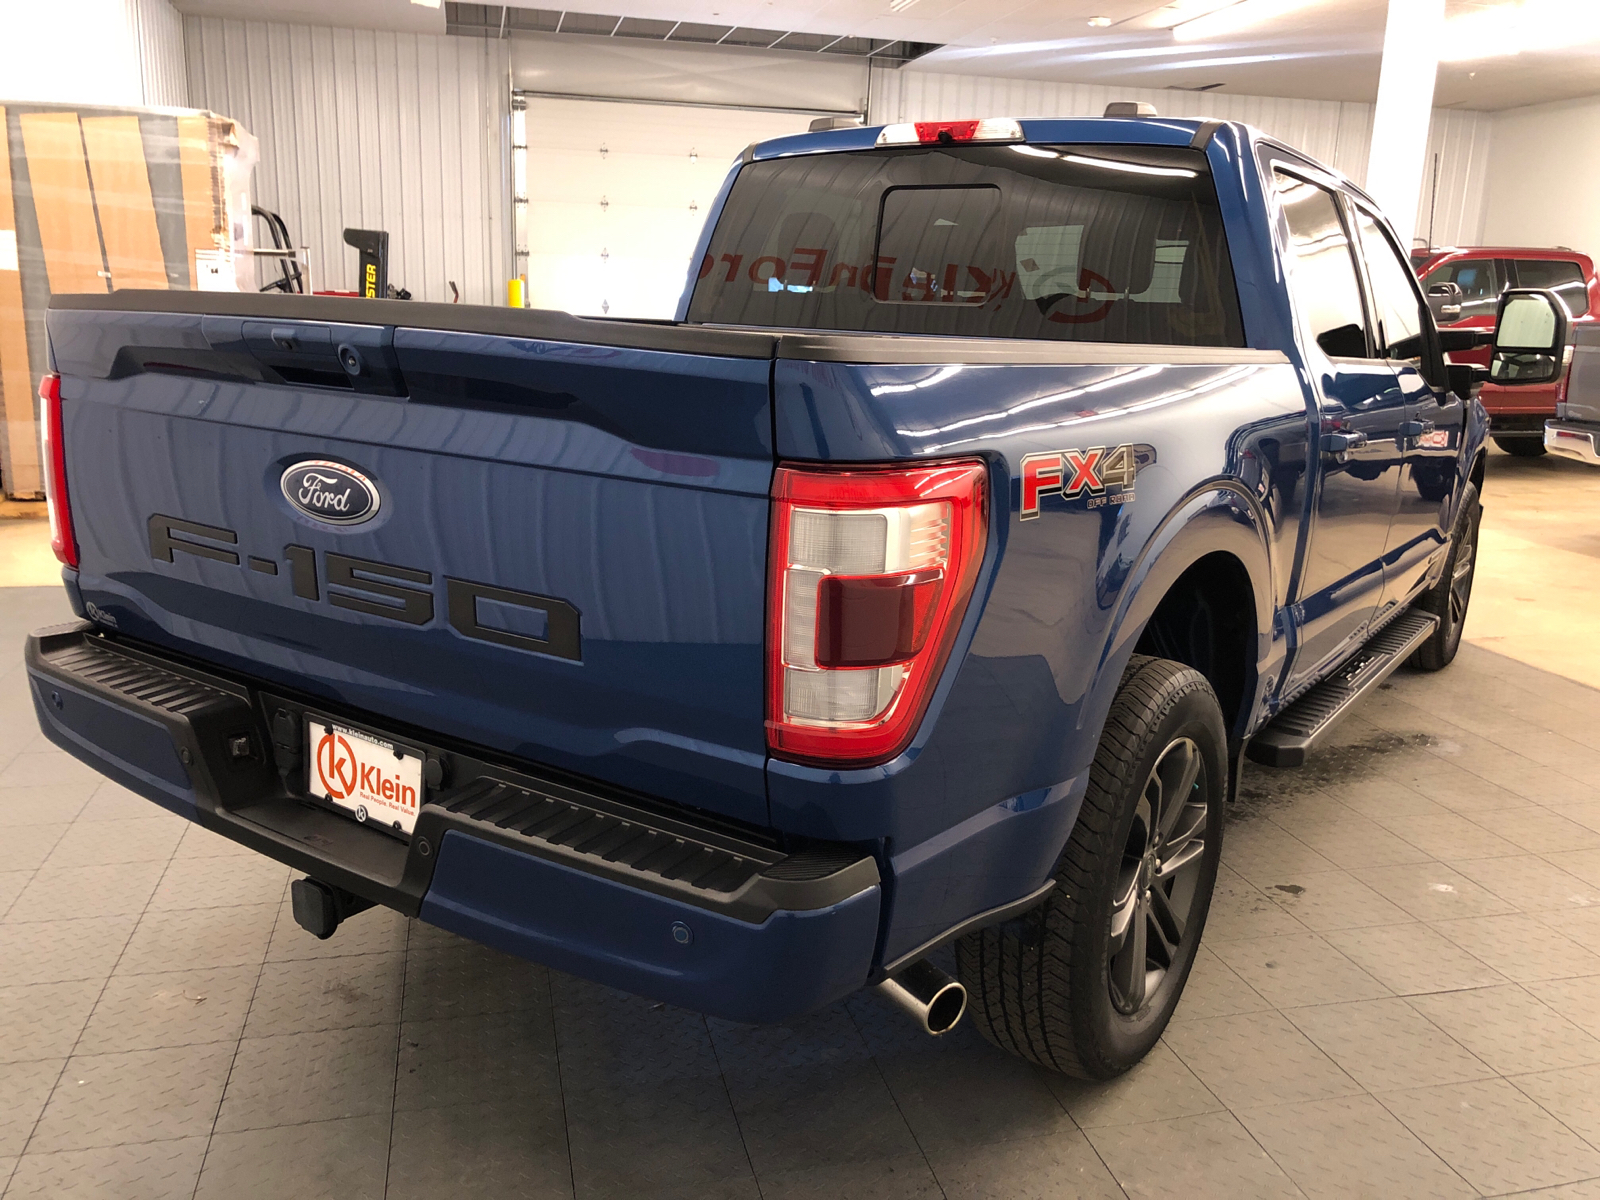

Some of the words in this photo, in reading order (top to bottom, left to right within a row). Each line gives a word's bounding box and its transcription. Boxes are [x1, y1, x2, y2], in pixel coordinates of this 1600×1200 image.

[298, 472, 352, 512] Ford
[1020, 443, 1136, 521] FX4
[1087, 496, 1107, 509] OFF
[148, 512, 583, 662] F-150
[332, 723, 394, 750] www.kleinauto.com
[360, 791, 370, 800] Real
[370, 795, 388, 806] People.
[389, 801, 399, 811] Real
[400, 806, 416, 816] Value.
[361, 762, 416, 808] Klein
